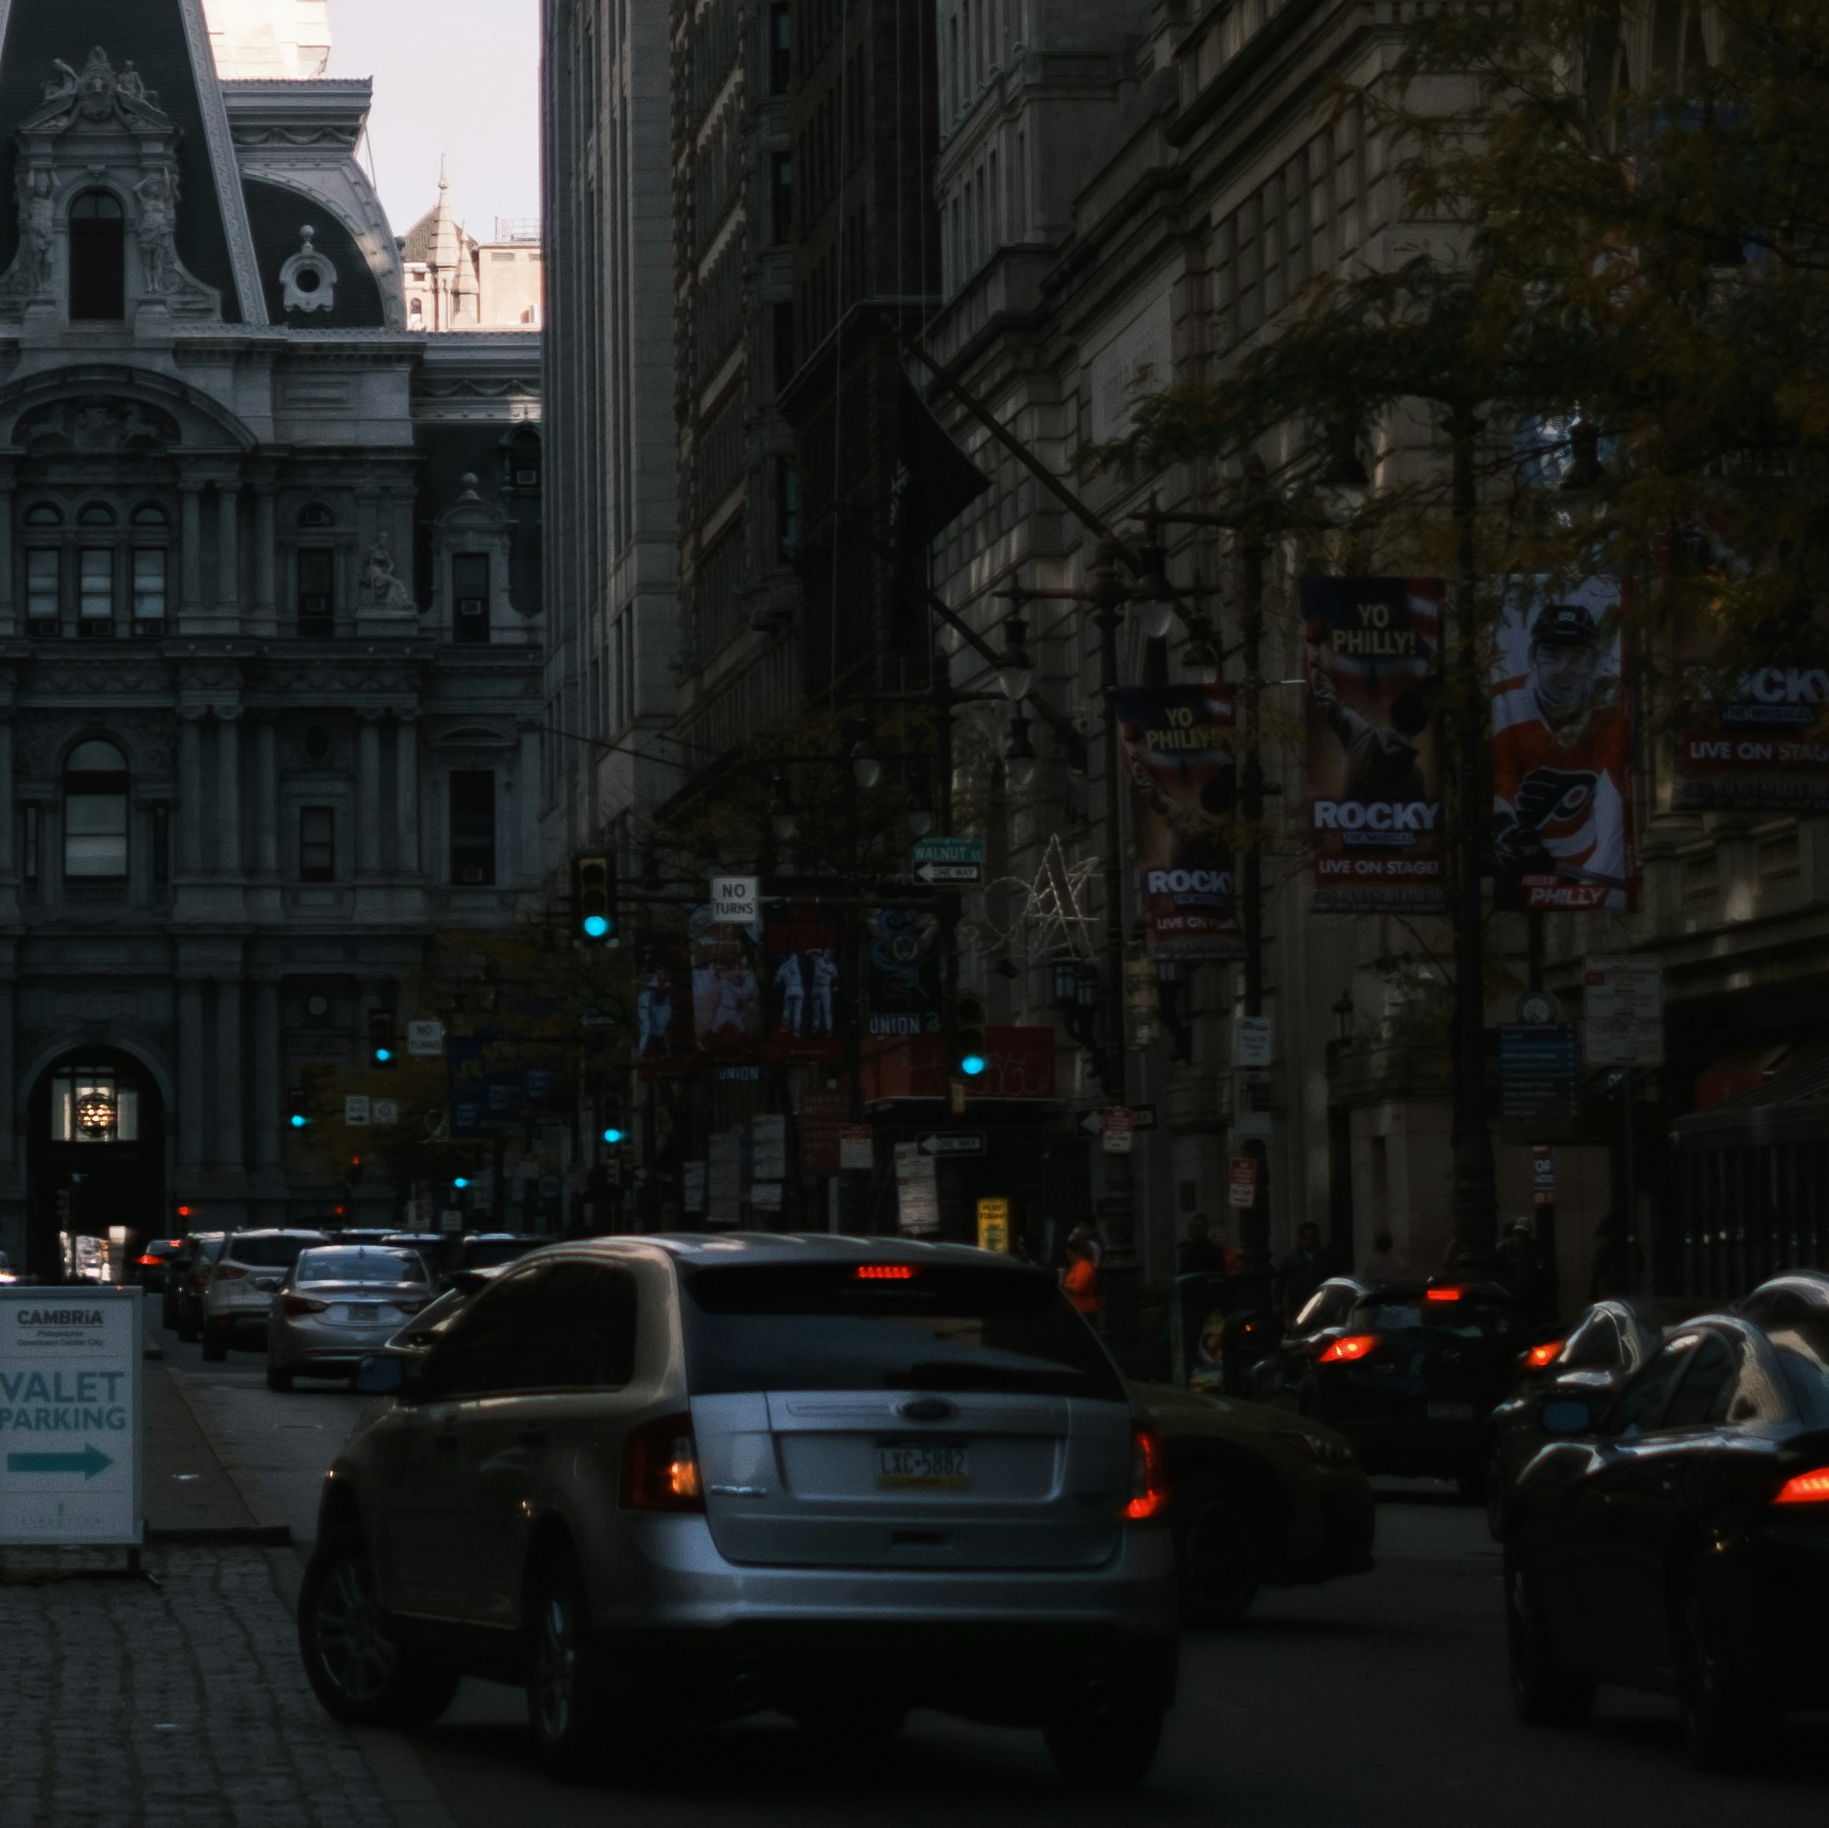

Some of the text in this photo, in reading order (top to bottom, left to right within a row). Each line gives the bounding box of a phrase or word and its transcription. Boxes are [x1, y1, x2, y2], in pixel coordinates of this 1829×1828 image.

[1356, 603, 1389, 627] YO
[1332, 629, 1416, 655] PHILLY!
[1164, 707, 1194, 728] YO
[1146, 727, 1212, 751] PHILLY
[1690, 742, 1731, 760] LIVE
[1737, 742, 1773, 761] ON
[1313, 801, 1441, 831] ROCKY
[915, 846, 967, 860] WALNUT
[1319, 860, 1439, 876] LIVE ON STAGE!
[722, 884, 747, 898] NO
[1529, 888, 1607, 906] PHILLY
[714, 902, 754, 915] TURNS
[869, 1013, 921, 1035] UNION
